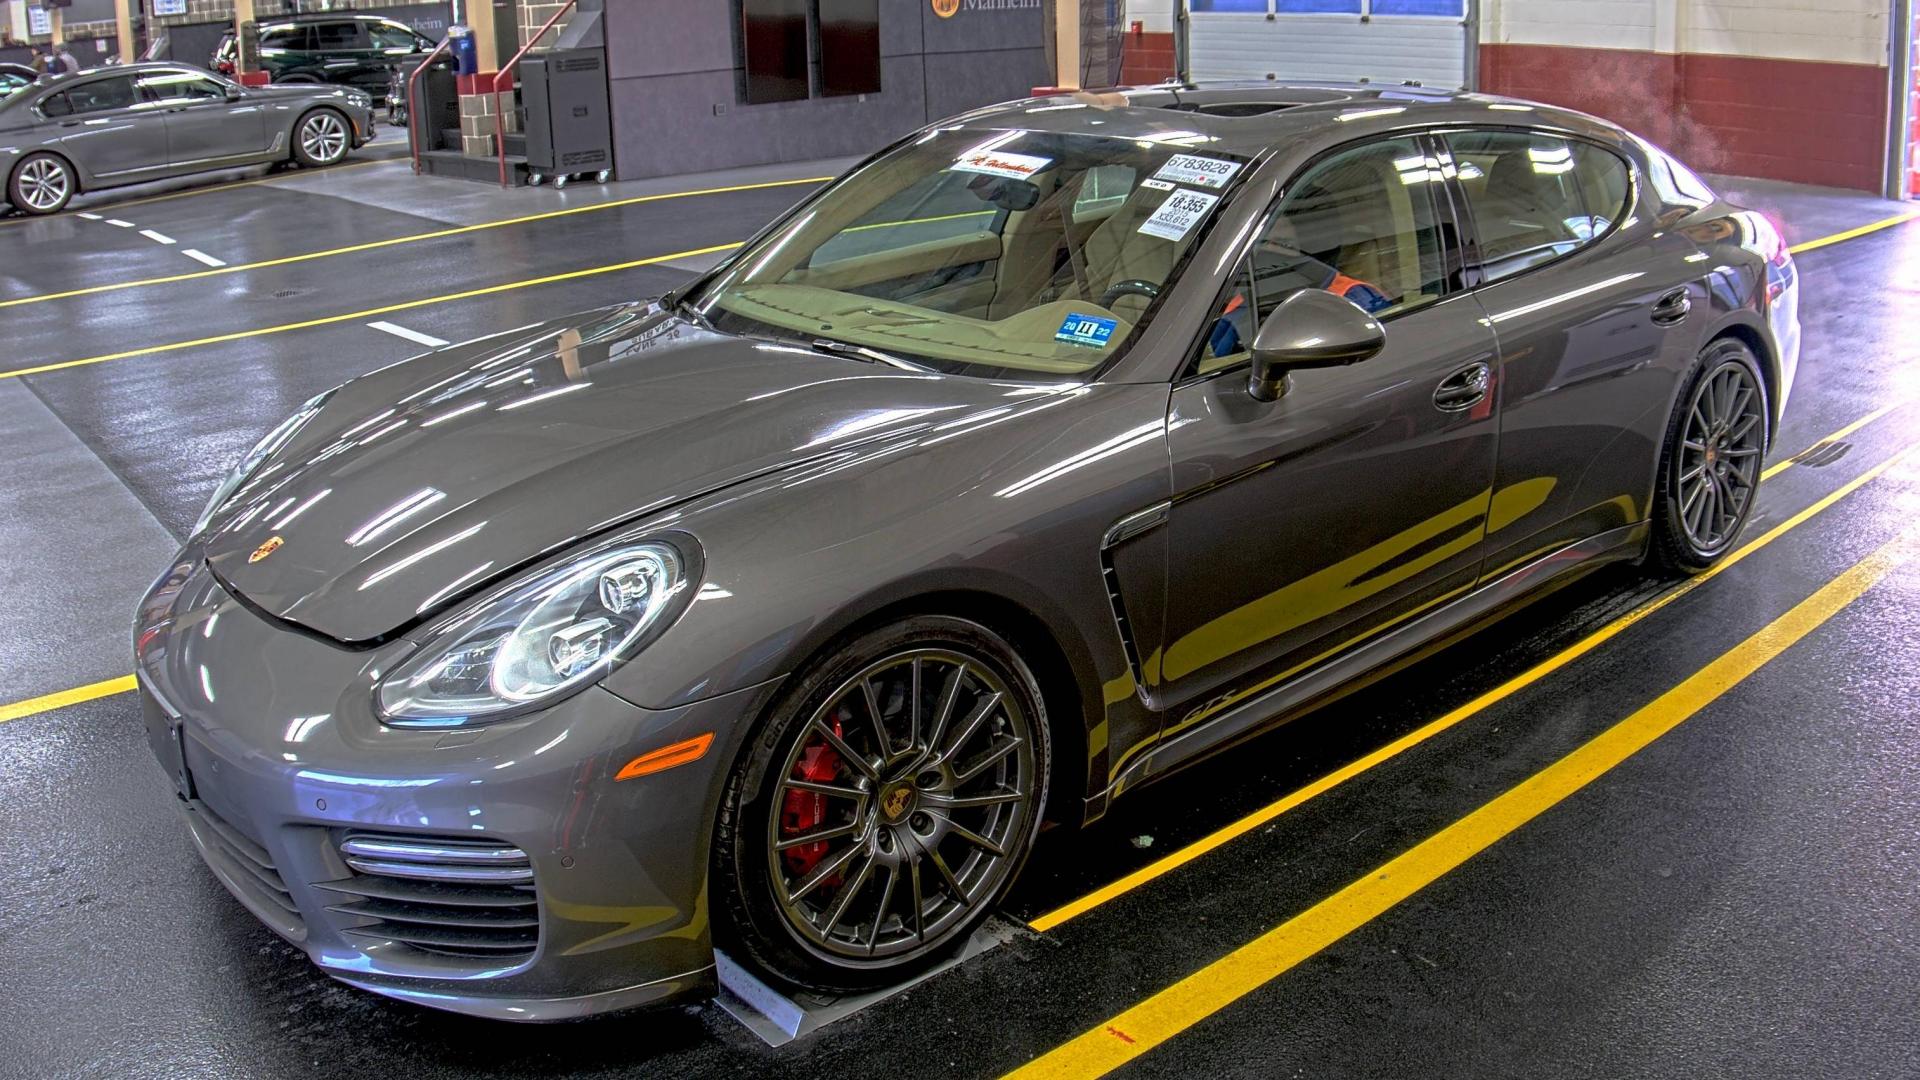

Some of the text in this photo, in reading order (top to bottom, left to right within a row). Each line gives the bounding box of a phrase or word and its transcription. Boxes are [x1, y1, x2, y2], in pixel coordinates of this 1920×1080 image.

[408, 17, 442, 30] nheim
[1167, 157, 1231, 175] 6783828
[1169, 196, 1207, 213] 18:355
[1169, 207, 1190, 218] 2015
[1156, 212, 1190, 226] X33,612
[1063, 321, 1111, 337] 20 11 22
[1181, 689, 1237, 724] GTS
